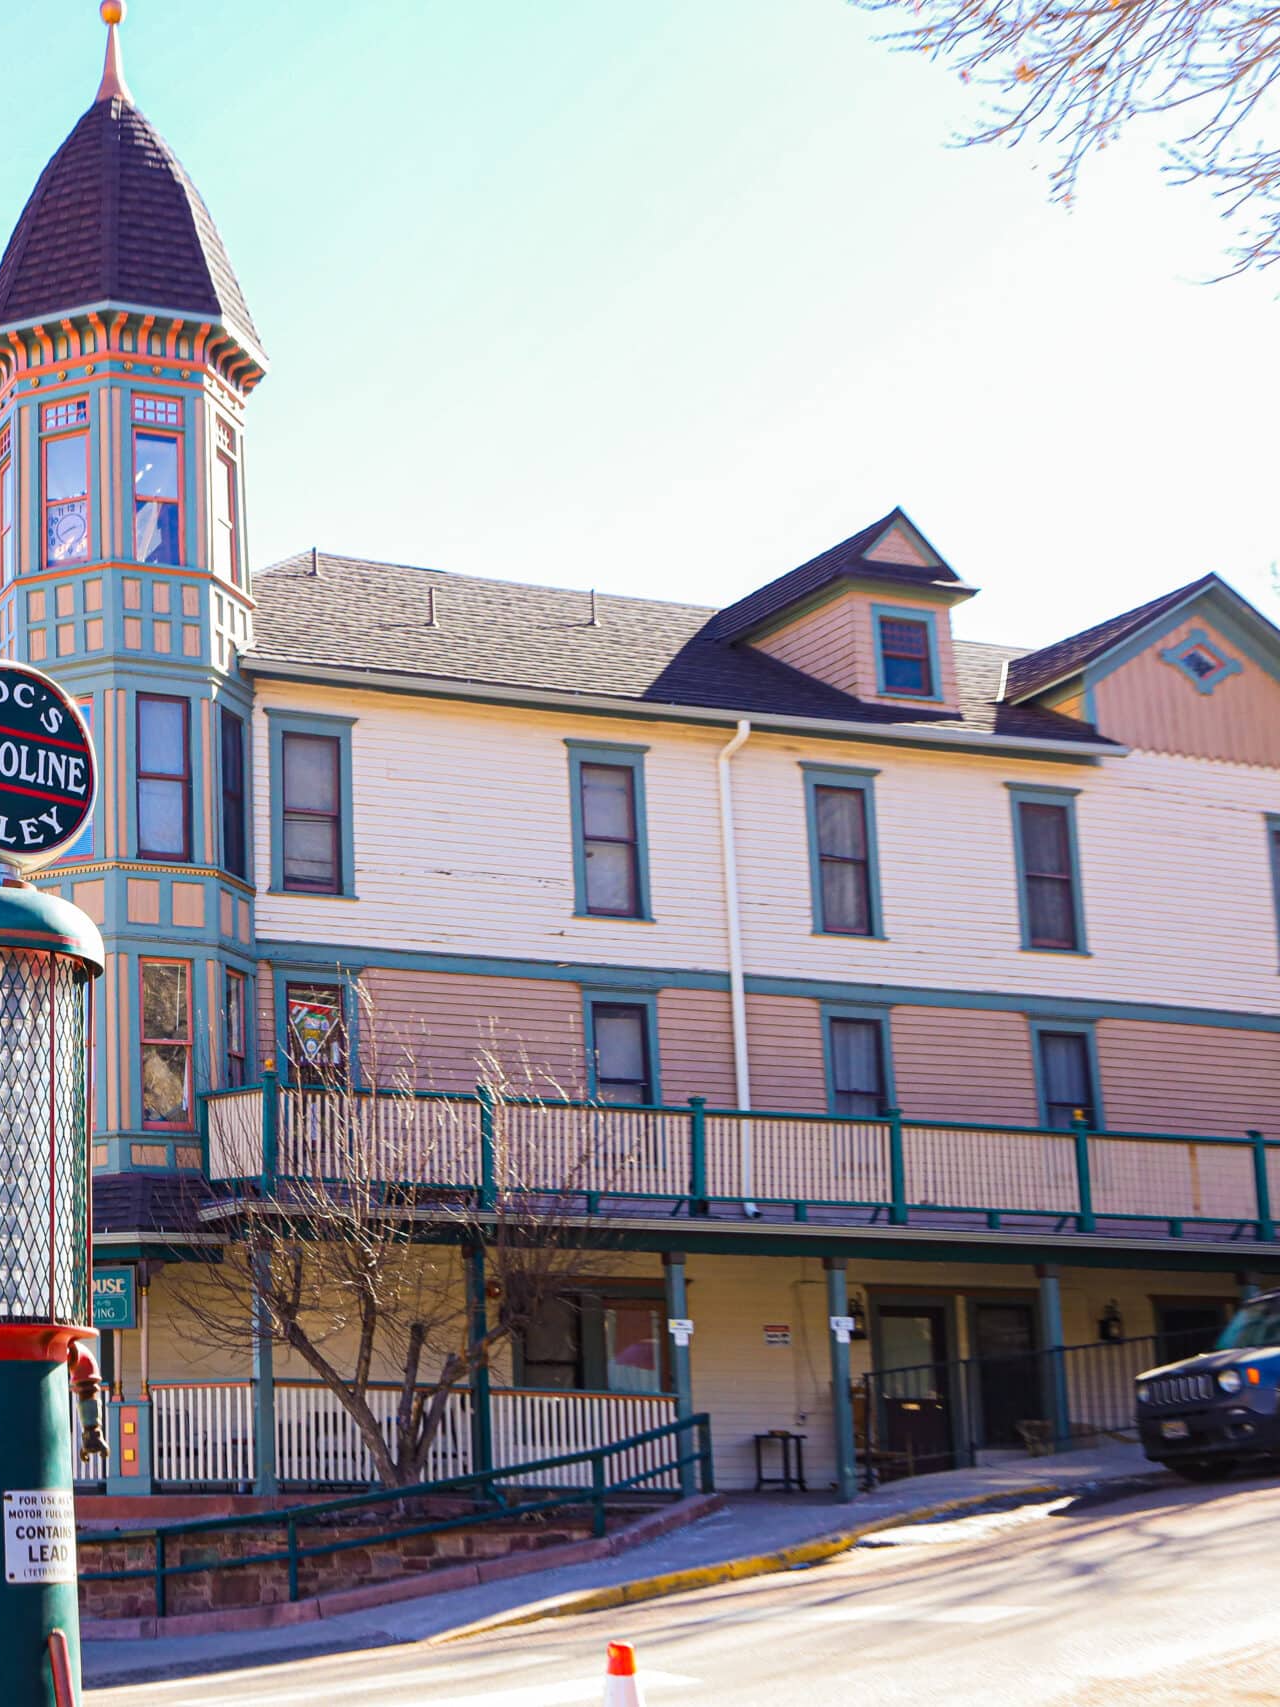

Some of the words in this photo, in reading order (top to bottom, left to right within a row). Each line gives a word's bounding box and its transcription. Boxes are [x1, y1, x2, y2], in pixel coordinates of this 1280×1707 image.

[19, 1495, 37, 1505] FOR
[40, 1495, 57, 1505] USE
[8, 1509, 42, 1520] MOTOR
[15, 1525, 72, 1540] CONTAINS
[28, 1544, 68, 1563] LEAD
